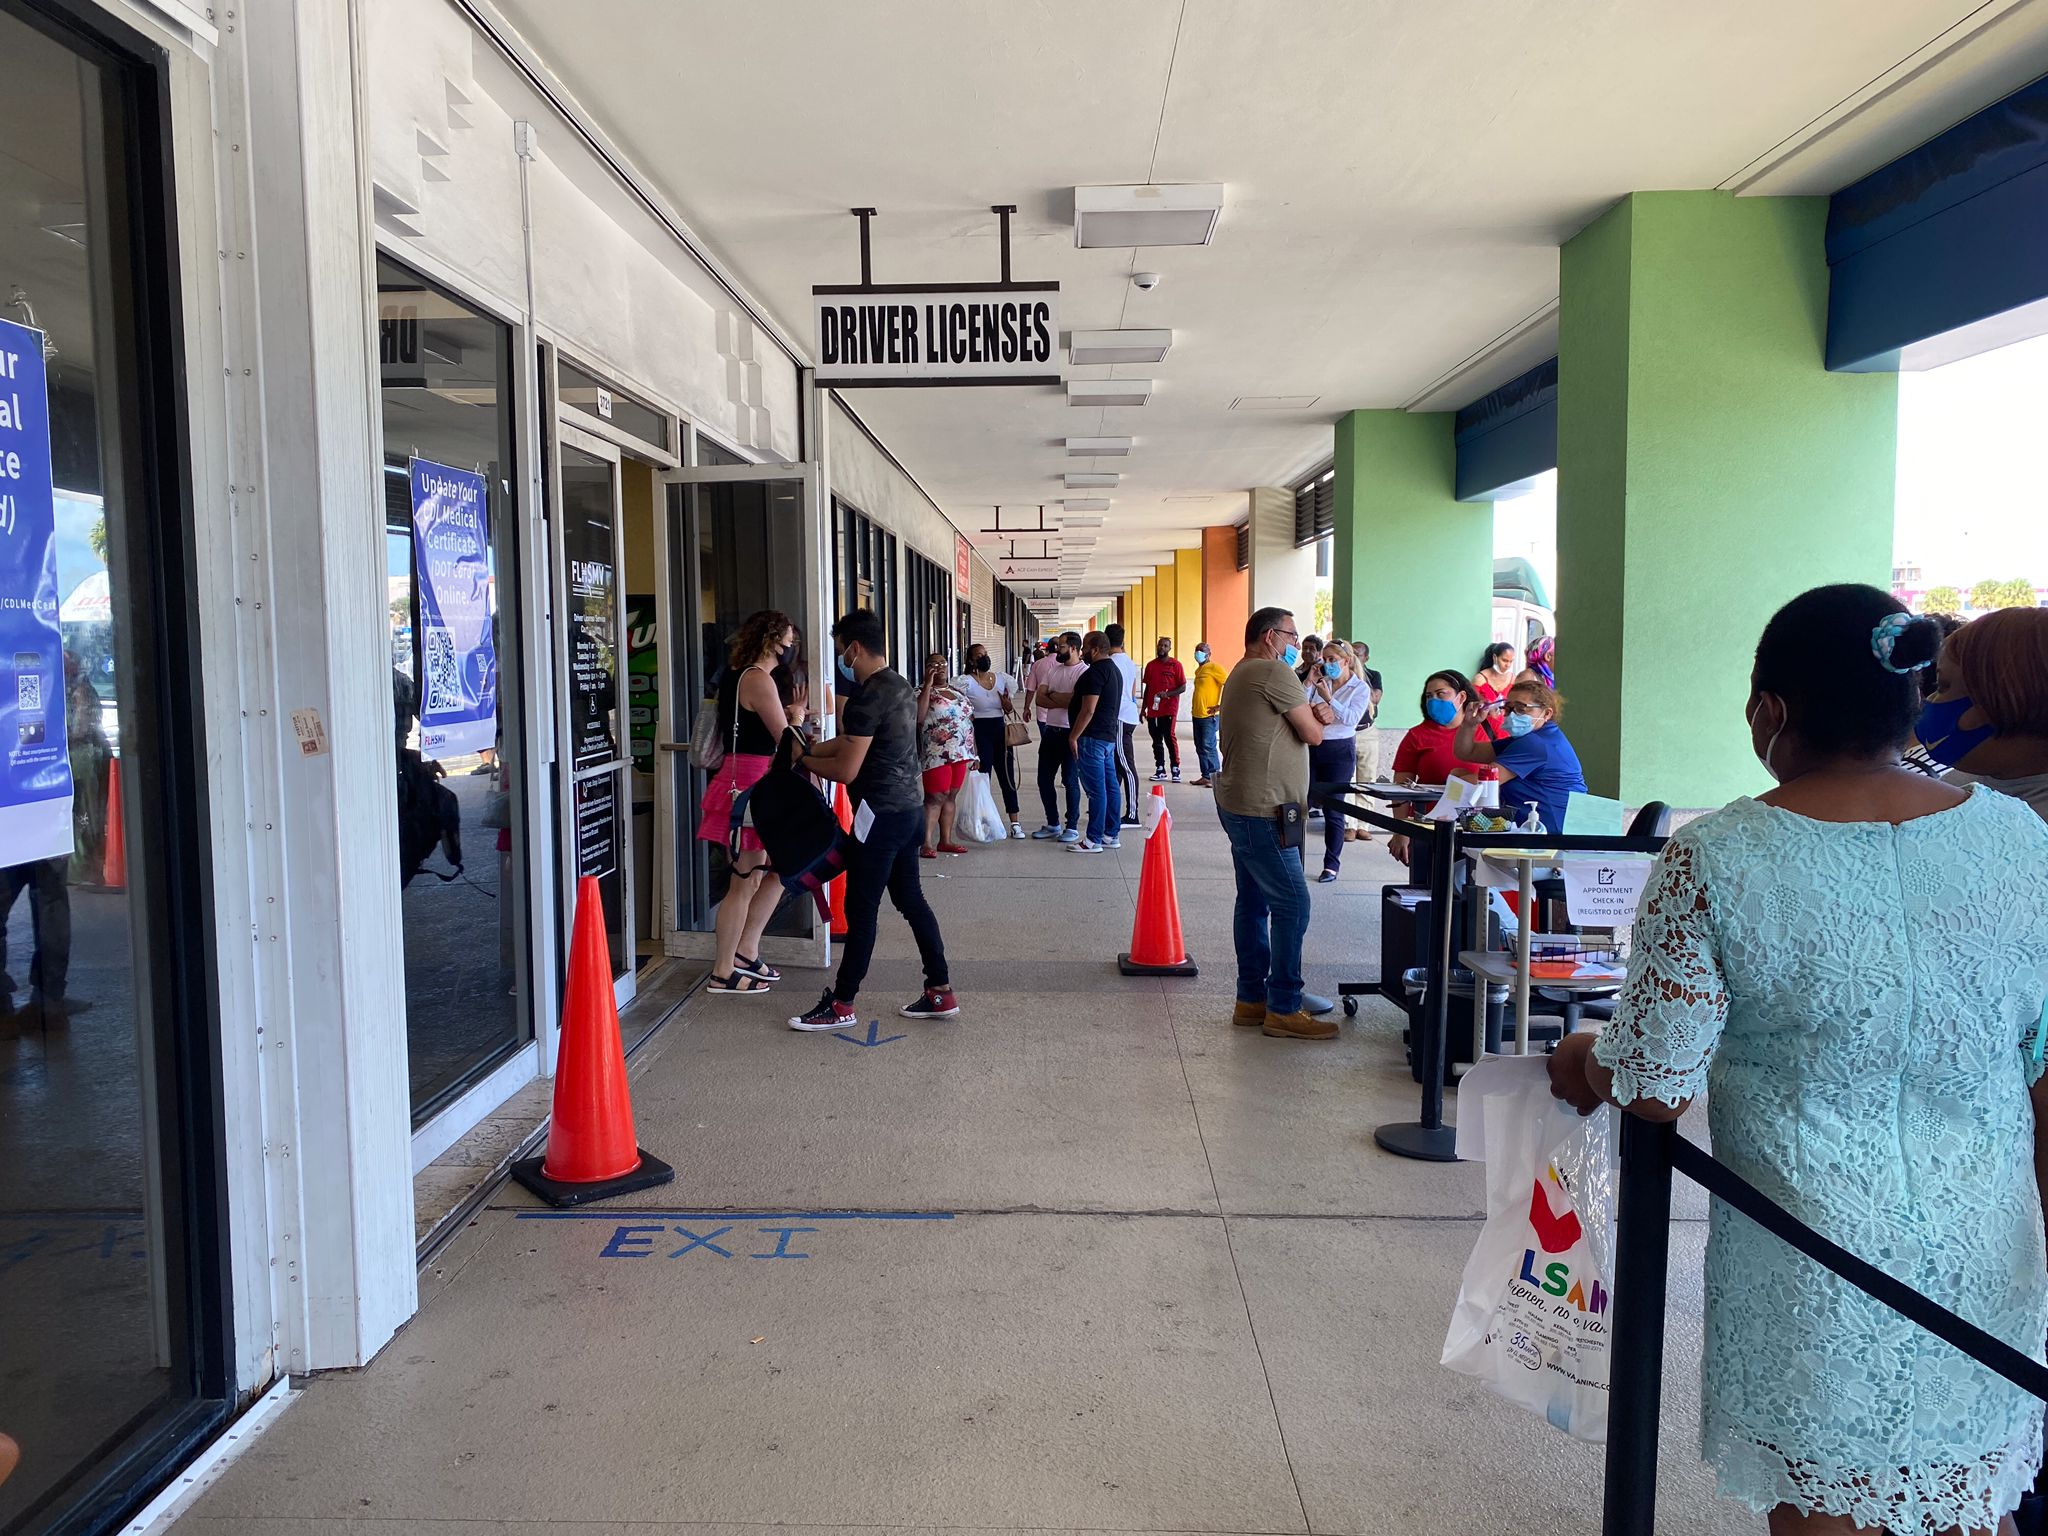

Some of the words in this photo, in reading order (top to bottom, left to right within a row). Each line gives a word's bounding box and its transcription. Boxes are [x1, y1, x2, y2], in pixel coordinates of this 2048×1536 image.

[821, 306, 919, 364] DRIVER
[926, 302, 1050, 363] LICENSES
[421, 473, 457, 497] Update
[457, 481, 478, 503] Your
[442, 505, 477, 529] Medical
[427, 531, 477, 554] Certificate
[572, 561, 604, 586] FLHSMV
[436, 585, 470, 605] Online.
[425, 734, 446, 747] FLHSMV
[1578, 908, 1611, 916] (REGISTRO
[1510, 1331, 1530, 1350] 35
